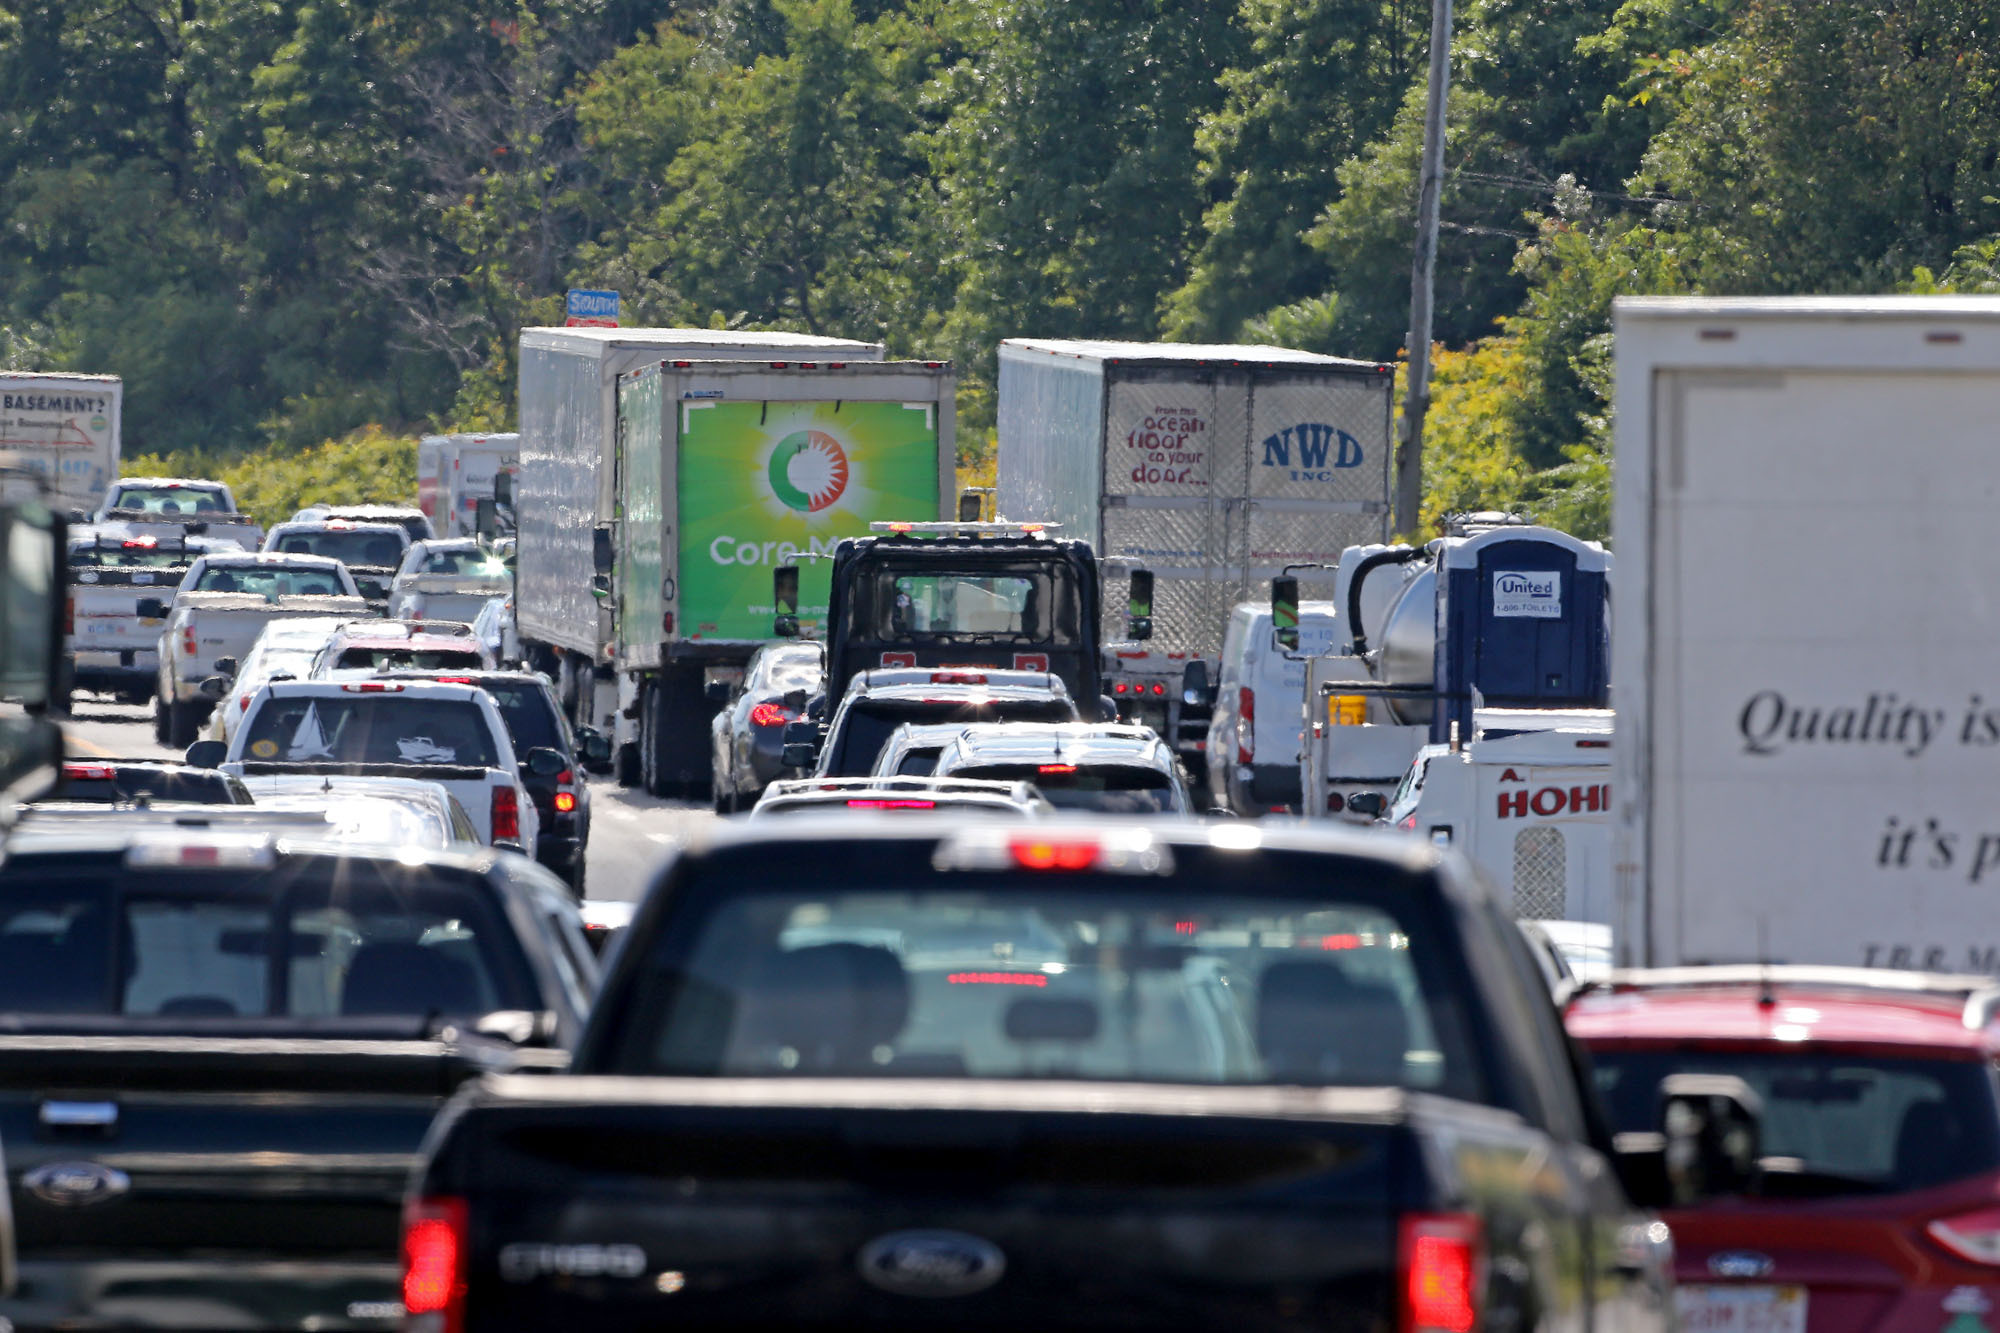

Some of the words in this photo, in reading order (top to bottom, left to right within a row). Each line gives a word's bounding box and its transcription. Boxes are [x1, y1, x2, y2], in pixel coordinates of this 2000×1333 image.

[571, 294, 616, 313] SOUTH
[4, 395, 105, 413] BASEMENT?
[1144, 416, 1205, 432] ocean
[1128, 430, 1189, 449] floor
[1262, 423, 1364, 468] NWD
[1169, 452, 1204, 465] your
[1289, 471, 1336, 482] INC.
[1502, 580, 1552, 593] United
[1739, 690, 1946, 757] Quality
[1876, 815, 1959, 870] it's
